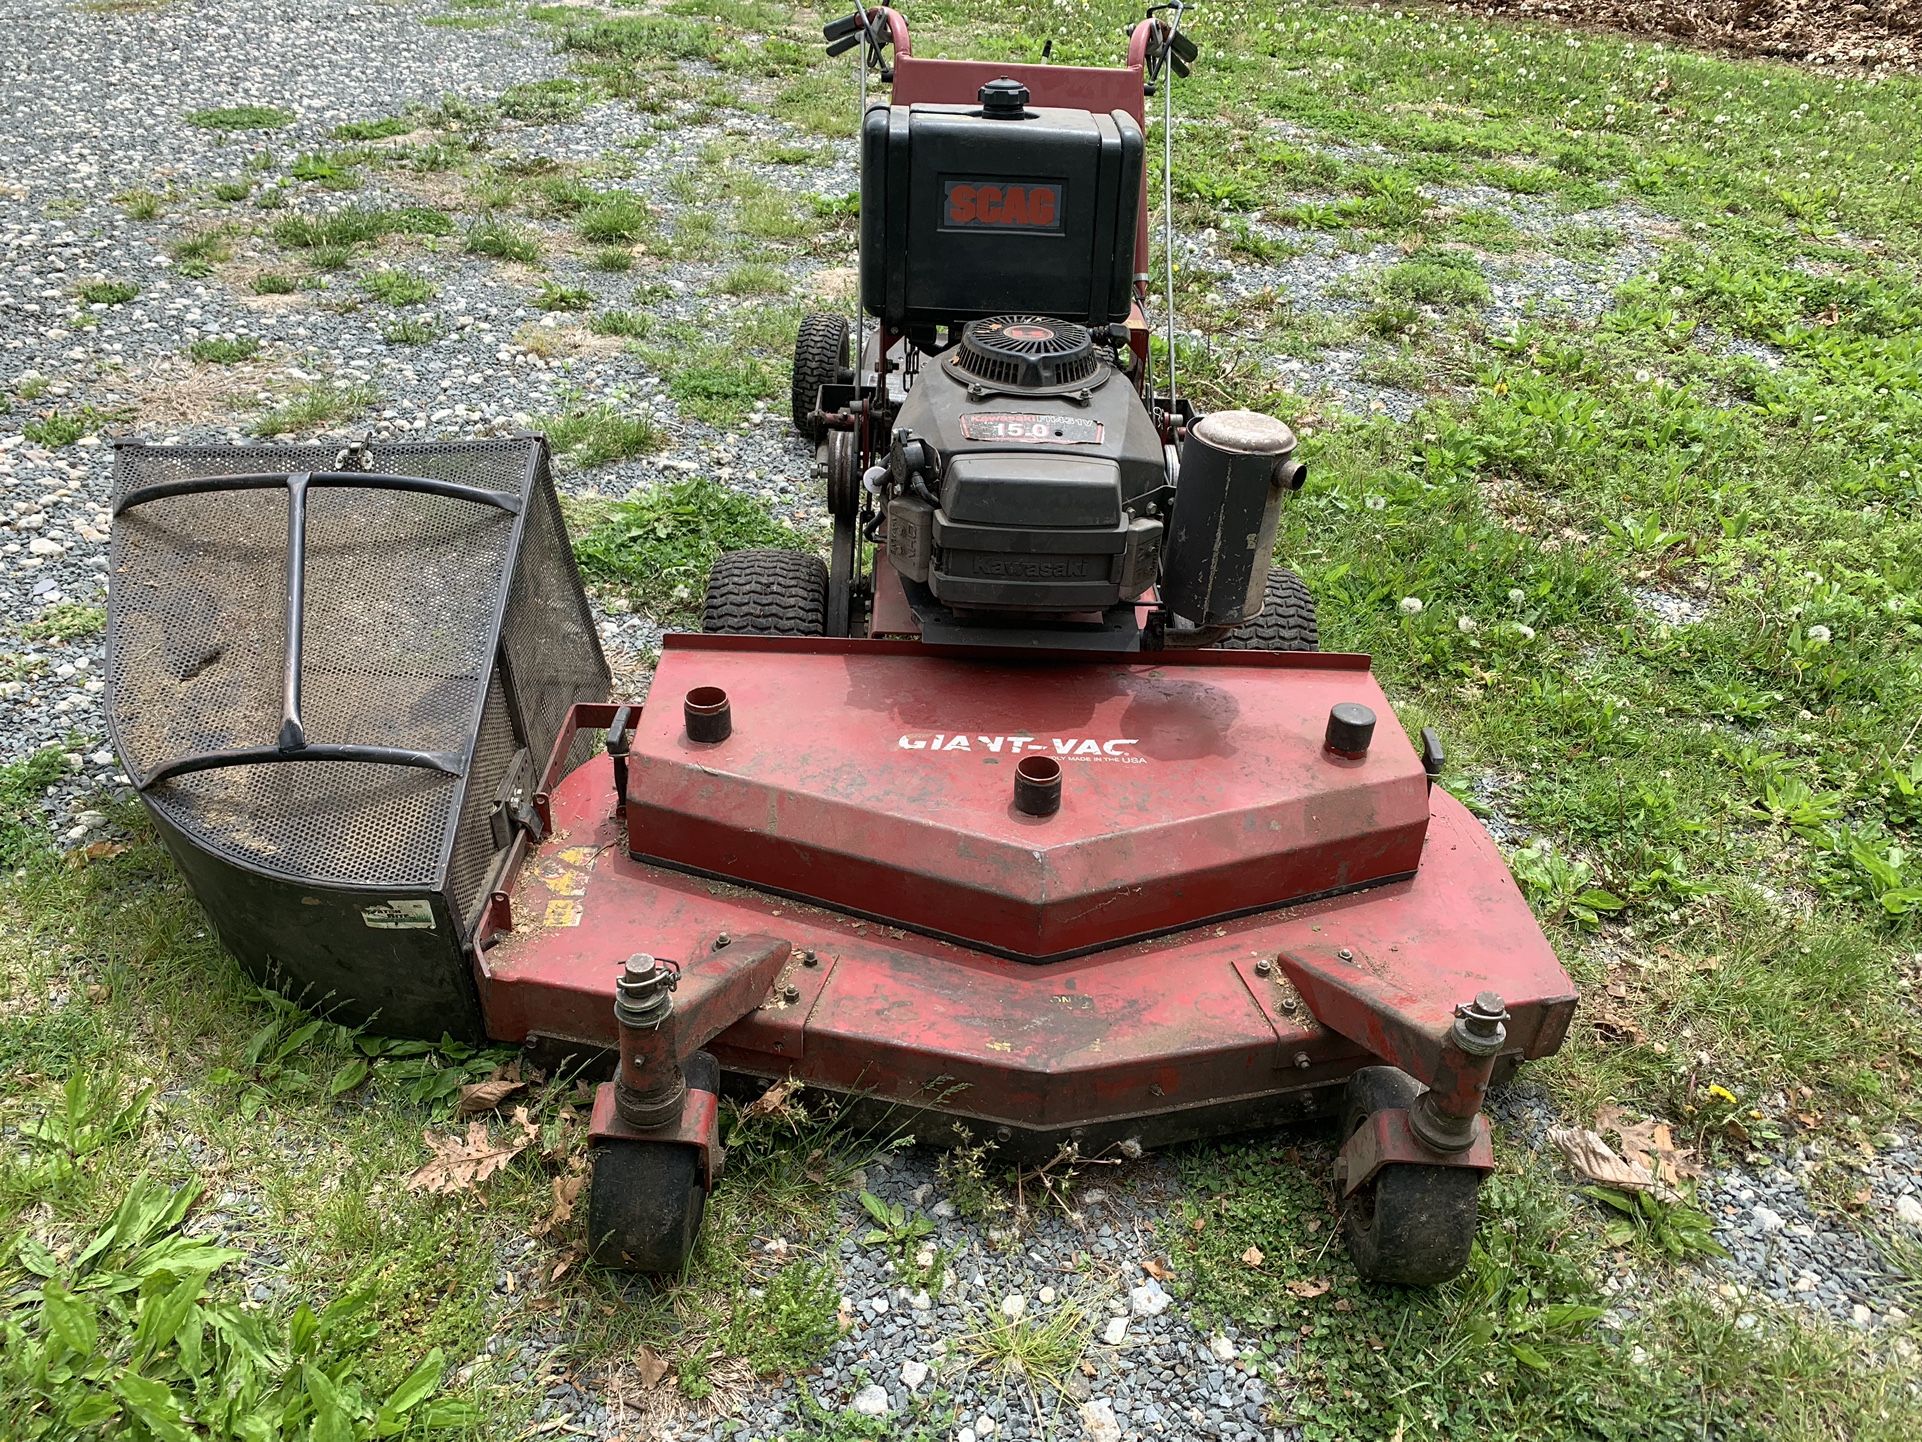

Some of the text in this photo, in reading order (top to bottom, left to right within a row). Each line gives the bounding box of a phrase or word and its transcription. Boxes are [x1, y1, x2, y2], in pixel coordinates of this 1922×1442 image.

[950, 184, 1056, 225] SCAG
[970, 414, 1036, 423] Kawasaki
[992, 422, 1048, 437] 15.0
[973, 554, 1089, 578] Kawasaki
